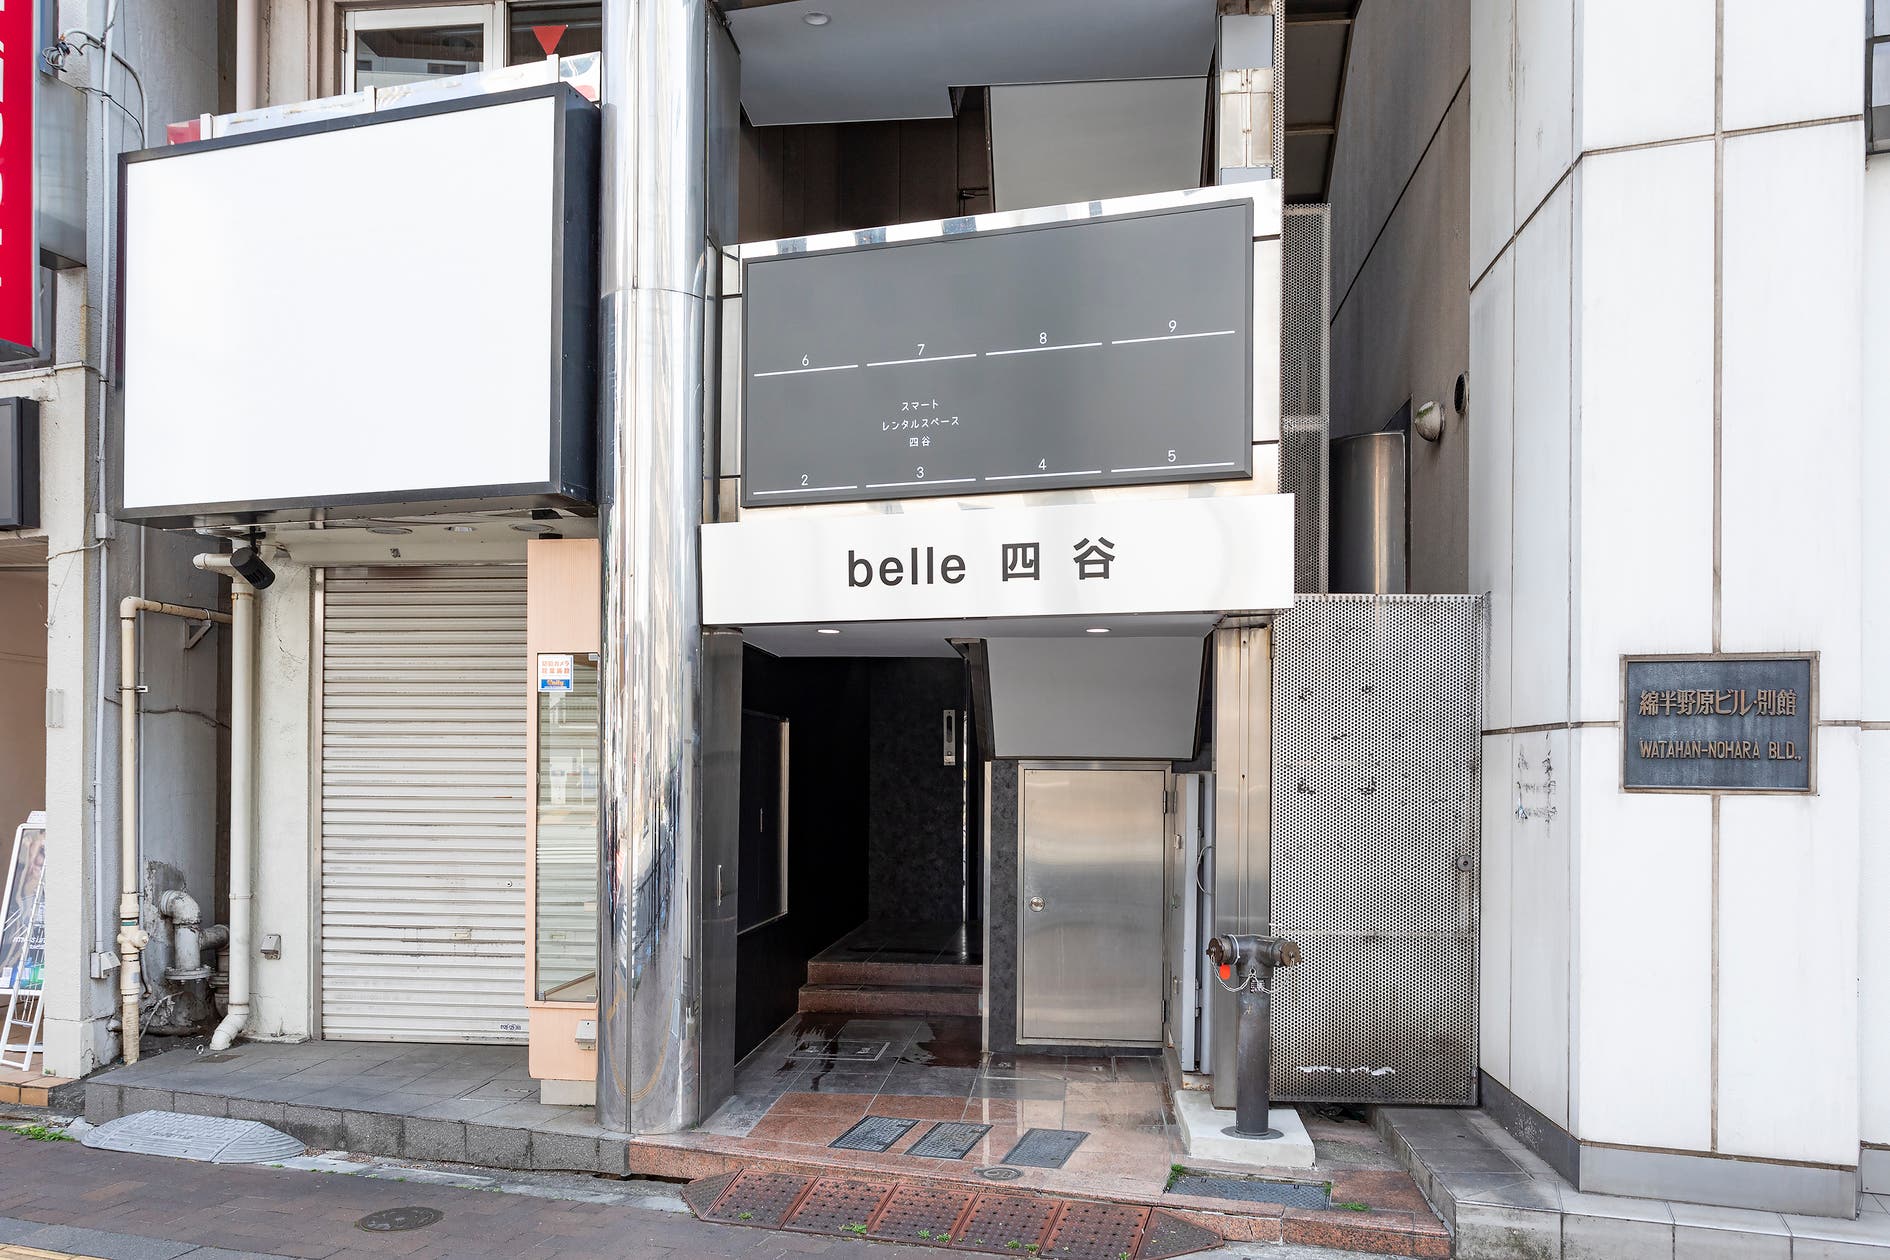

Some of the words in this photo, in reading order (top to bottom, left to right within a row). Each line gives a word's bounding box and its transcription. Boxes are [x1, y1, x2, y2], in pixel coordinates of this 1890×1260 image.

[1168, 319, 1178, 333] 9
[1039, 332, 1047, 345] 8
[917, 343, 926, 355] 7
[801, 354, 809, 366] 6
[901, 399, 939, 412] スマート
[882, 416, 960, 431] レンタルスペース
[909, 436, 931, 447] 四谷
[1168, 449, 1177, 462] 5
[1038, 458, 1047, 470] 4
[916, 466, 925, 479] 3
[801, 474, 809, 486] 2
[848, 547, 967, 588] belle
[1639, 738, 1761, 760] WATAHAN-NOHARA
